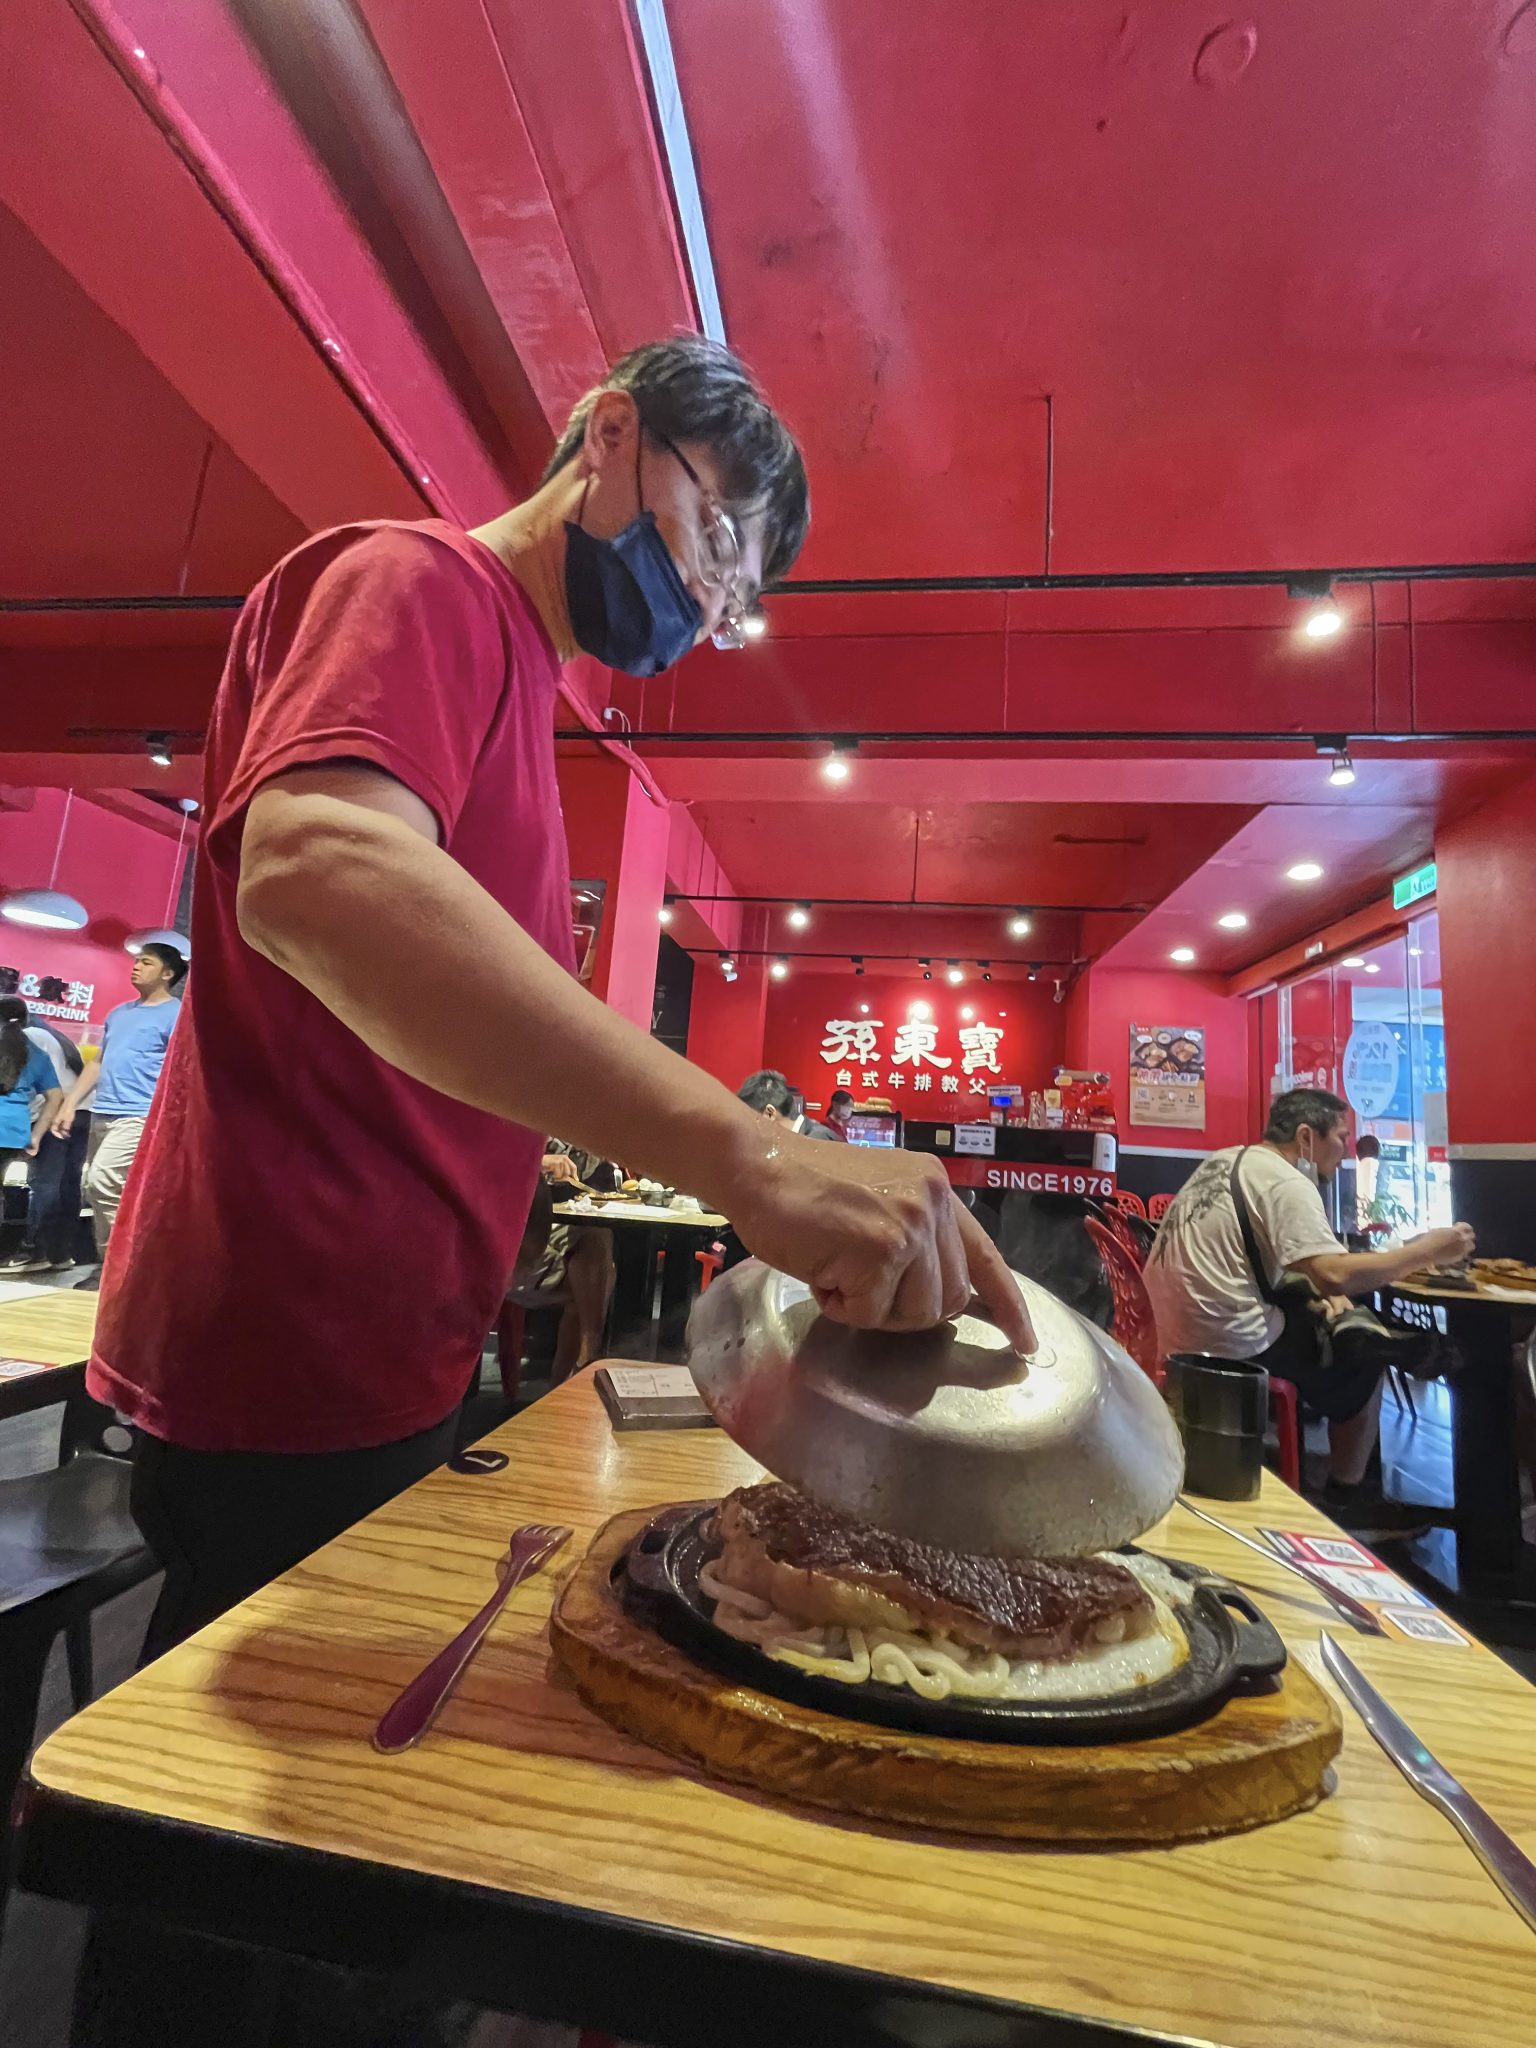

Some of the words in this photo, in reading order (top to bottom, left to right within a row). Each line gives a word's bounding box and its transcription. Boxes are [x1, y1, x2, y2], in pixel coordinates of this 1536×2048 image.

[836, 1068, 986, 1095] 台式牛排教父
